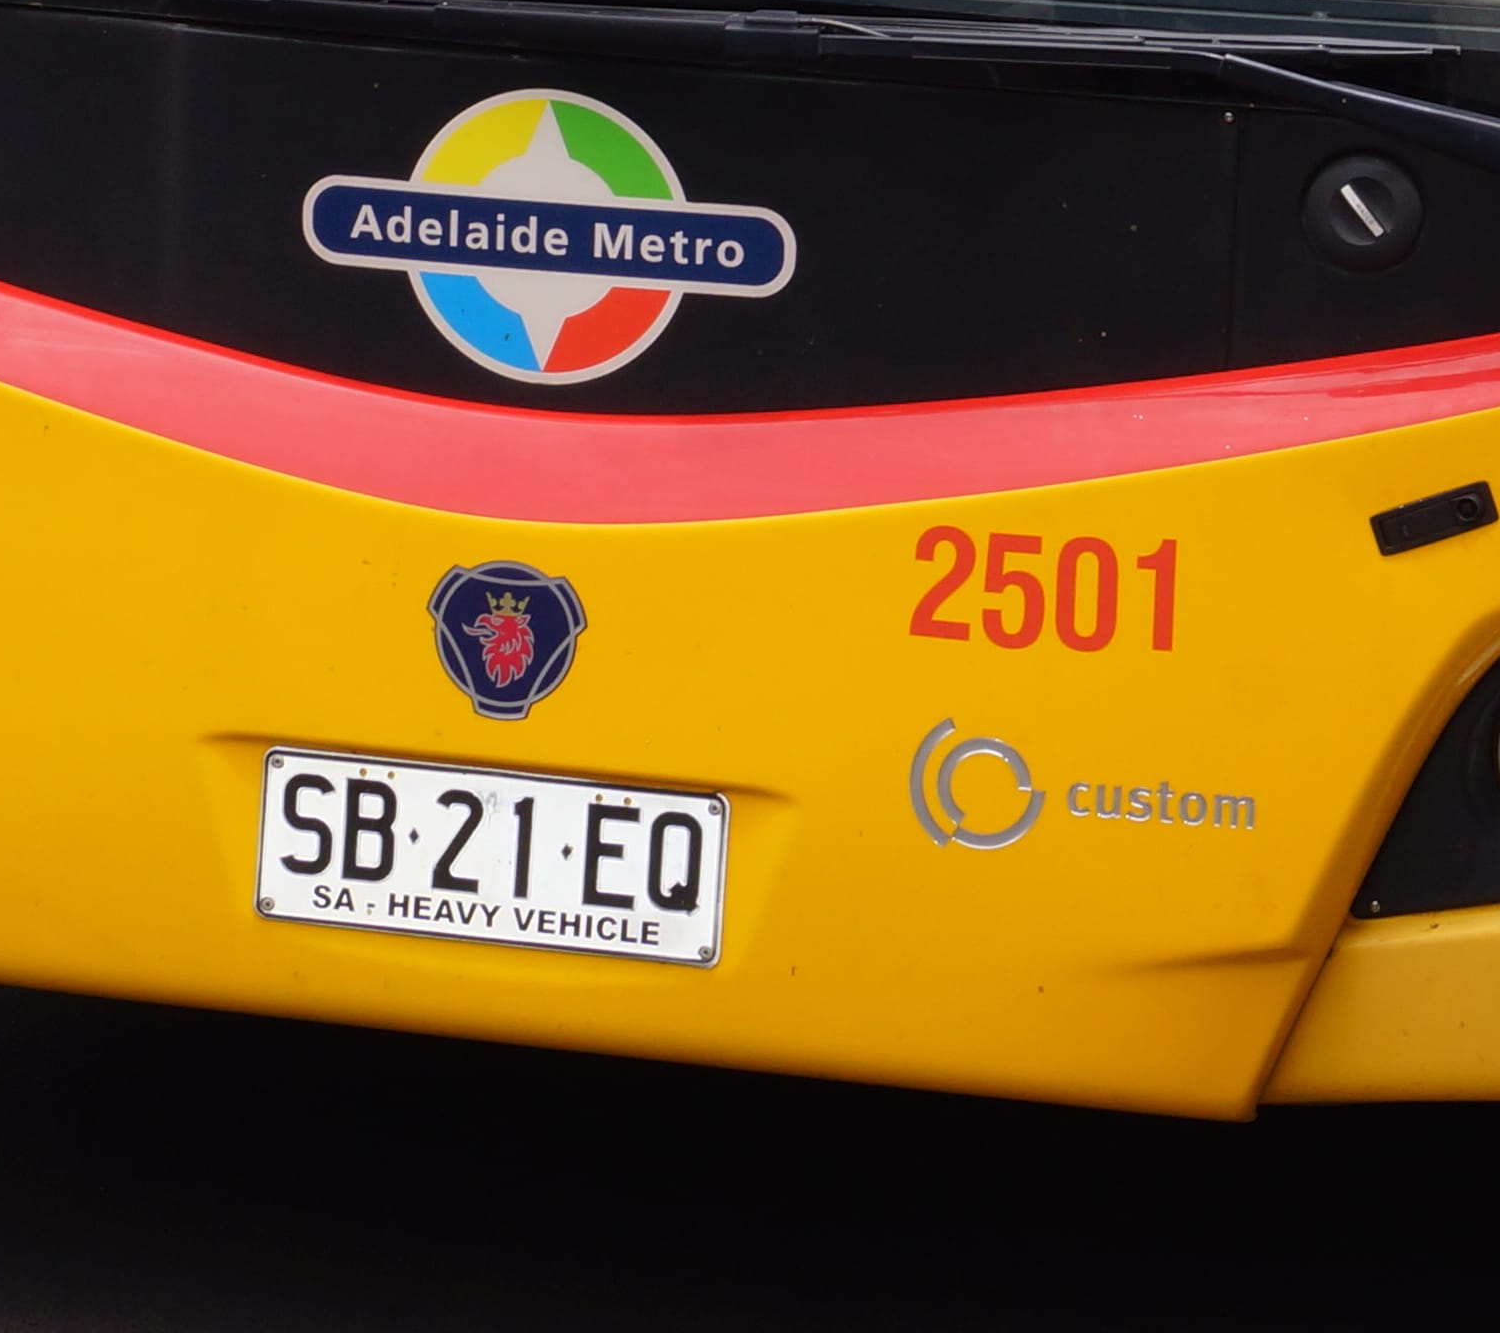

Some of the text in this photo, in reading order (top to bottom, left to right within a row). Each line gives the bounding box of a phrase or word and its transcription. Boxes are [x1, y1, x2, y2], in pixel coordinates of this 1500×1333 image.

[350, 204, 746, 269] Adelaide Metro
[909, 524, 1178, 653] 2501
[1066, 780, 1256, 830] custom
[311, 884, 356, 914] SA
[387, 893, 502, 929] HEAVY
[512, 906, 661, 947] VEHICLE
